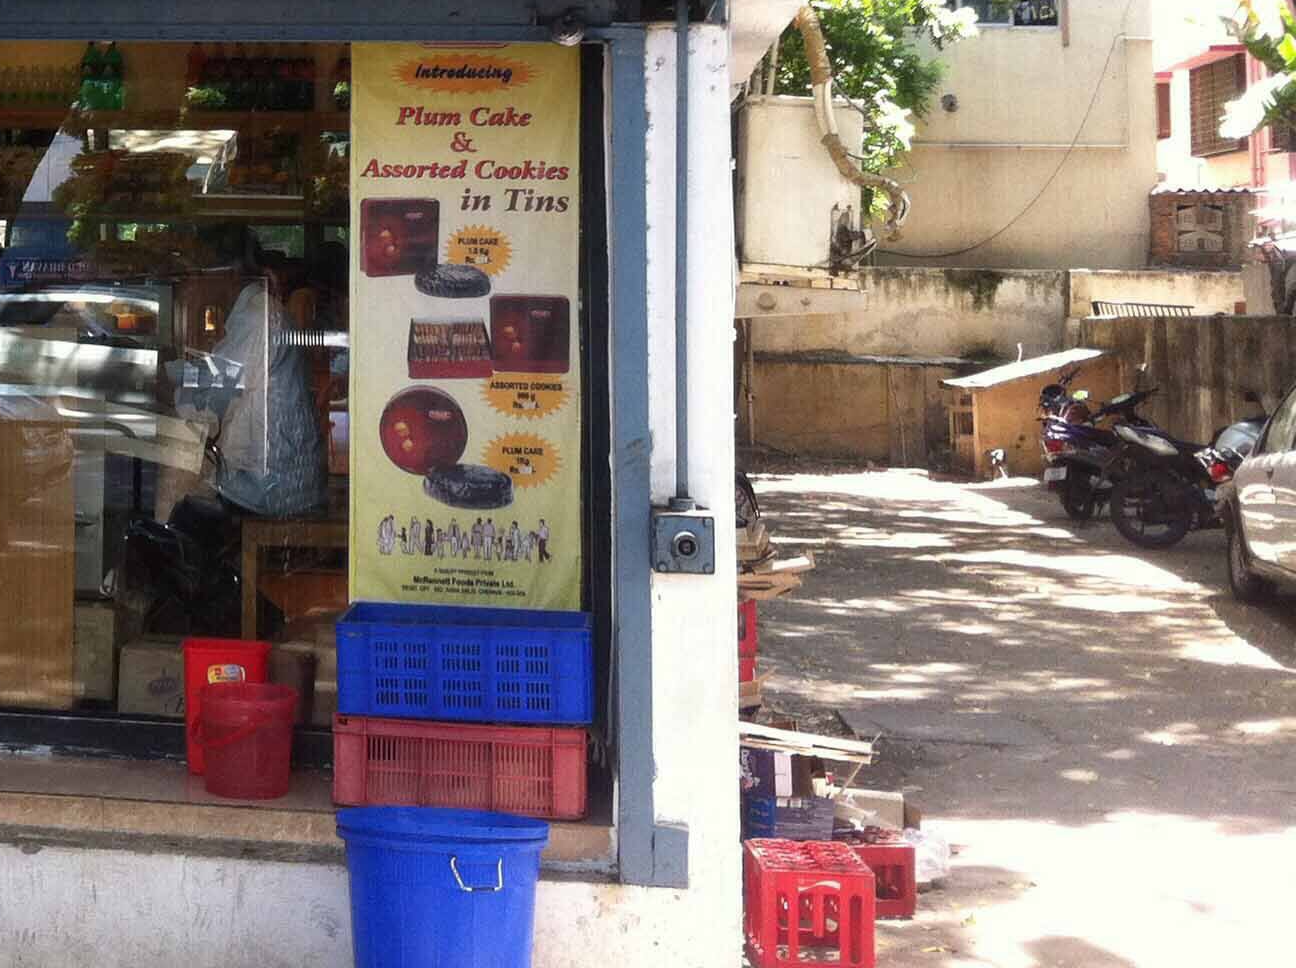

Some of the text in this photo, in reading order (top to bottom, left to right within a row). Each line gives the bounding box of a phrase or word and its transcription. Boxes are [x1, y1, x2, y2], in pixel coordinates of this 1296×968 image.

[415, 63, 513, 83] Introducing
[395, 106, 533, 128] Plum Cake
[450, 131, 477, 153] &
[360, 158, 570, 181] Assorted Cookies
[460, 187, 570, 213] in Tins
